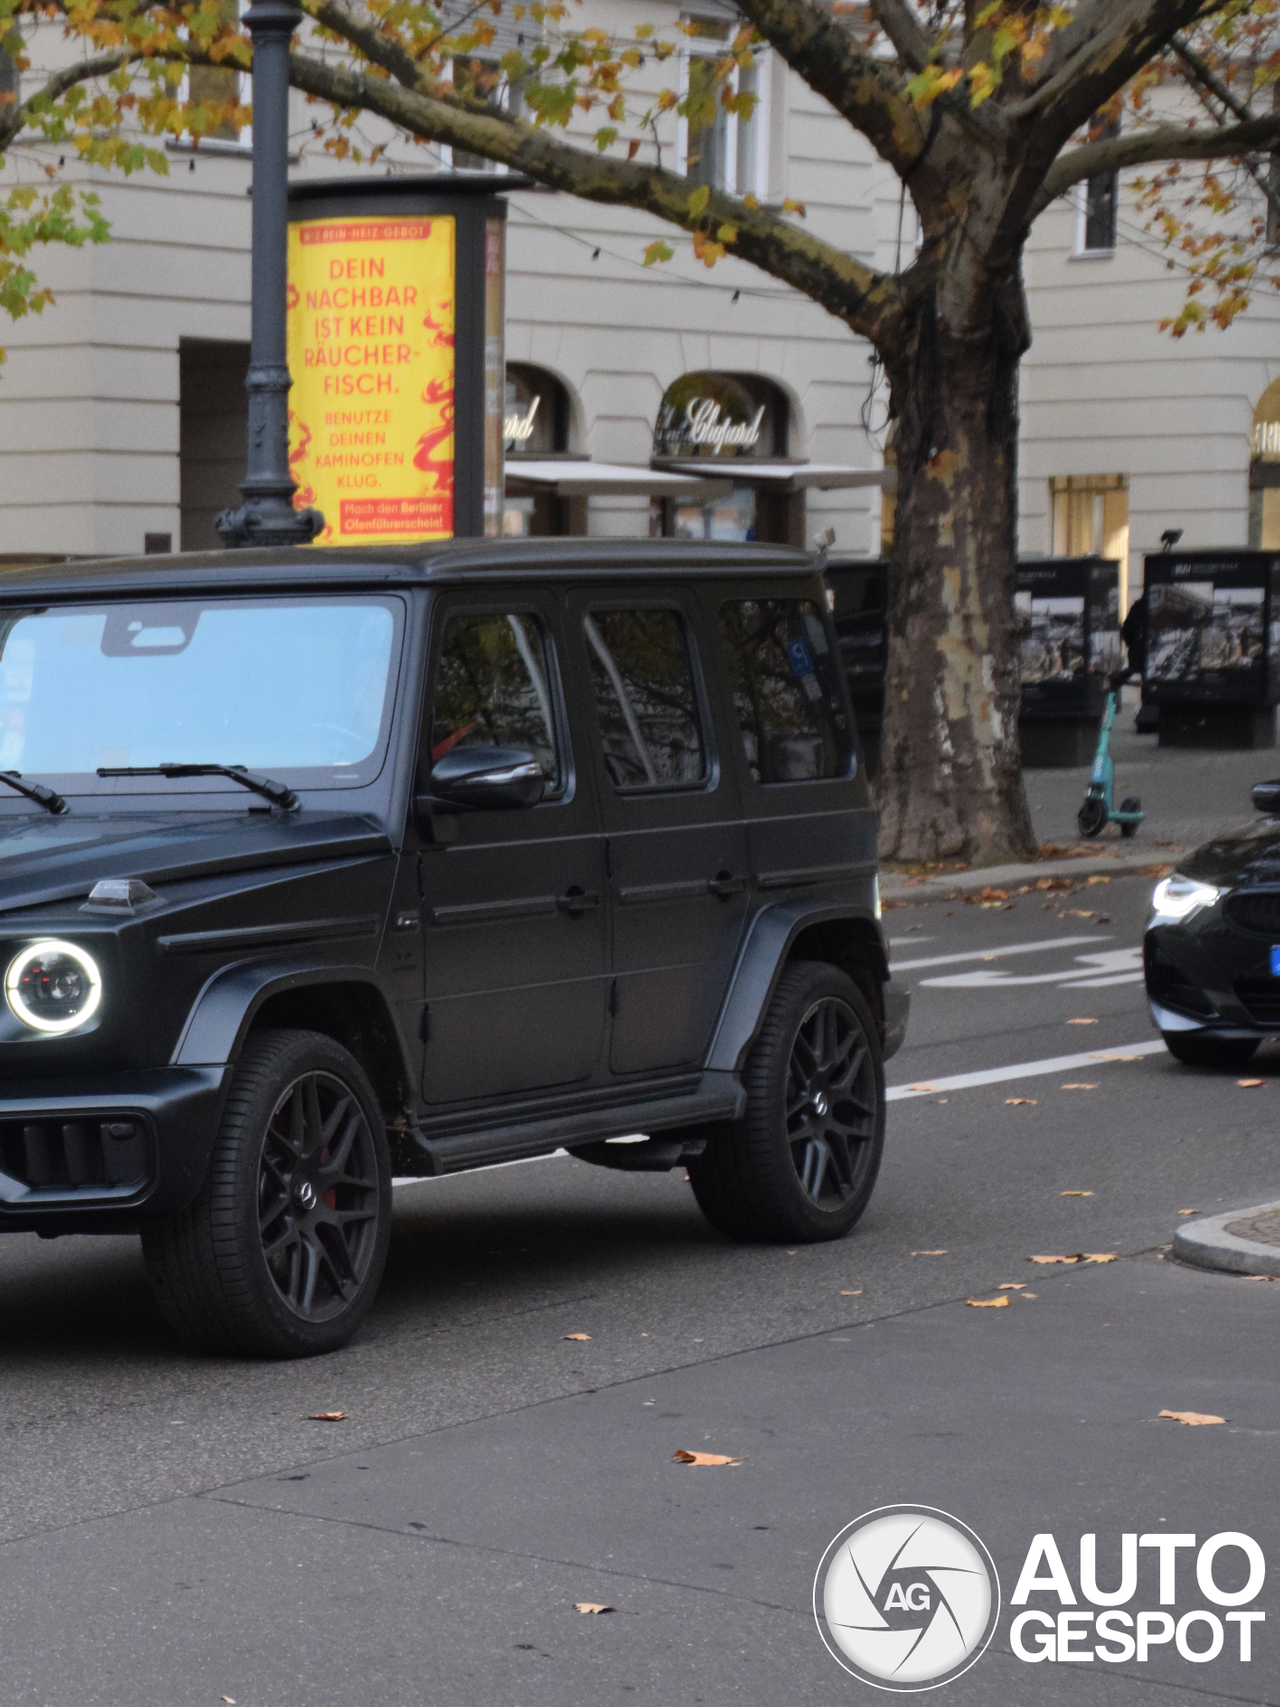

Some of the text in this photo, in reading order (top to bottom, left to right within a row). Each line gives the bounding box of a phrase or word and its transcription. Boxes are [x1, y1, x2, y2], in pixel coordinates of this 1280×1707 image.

[329, 257, 385, 280] DEIN
[306, 285, 418, 310] NACHBAR
[315, 315, 404, 339] IST KEIN
[304, 341, 422, 367] RÄUCHER-
[323, 373, 400, 396] FISCH.
[325, 410, 392, 425] BENUTZE
[687, 396, 765, 455] Chopard
[329, 432, 386, 446] DEINEN
[315, 453, 404, 468] KAMINOFEN
[337, 474, 382, 488] KLUG.
[344, 501, 443, 514] Mach den Berliner
[344, 516, 443, 530] Ofenführerschein!
